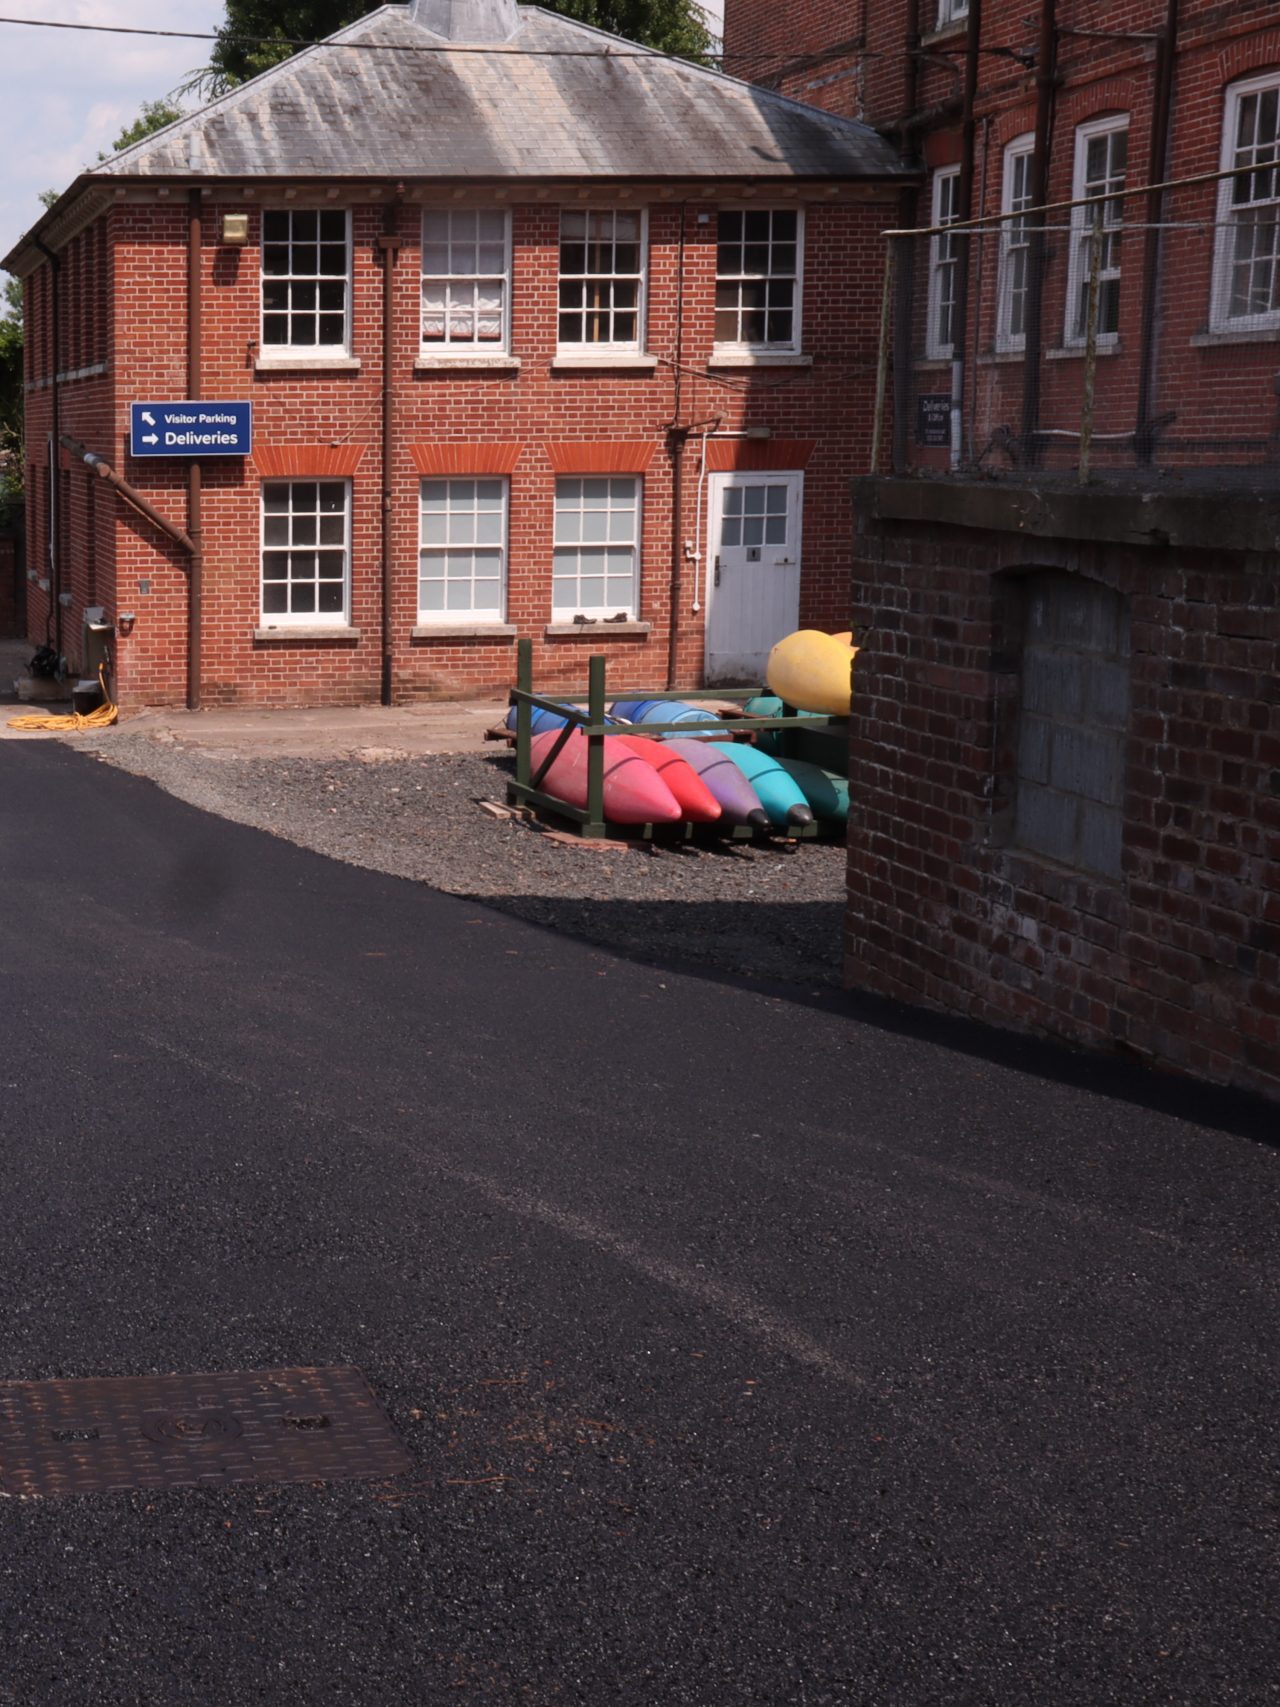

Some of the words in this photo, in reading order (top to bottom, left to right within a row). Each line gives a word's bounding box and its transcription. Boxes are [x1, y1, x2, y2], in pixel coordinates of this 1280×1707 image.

[164, 414, 197, 424] Visitor
[199, 413, 237, 425] Parking
[165, 431, 238, 445] Deliveries
